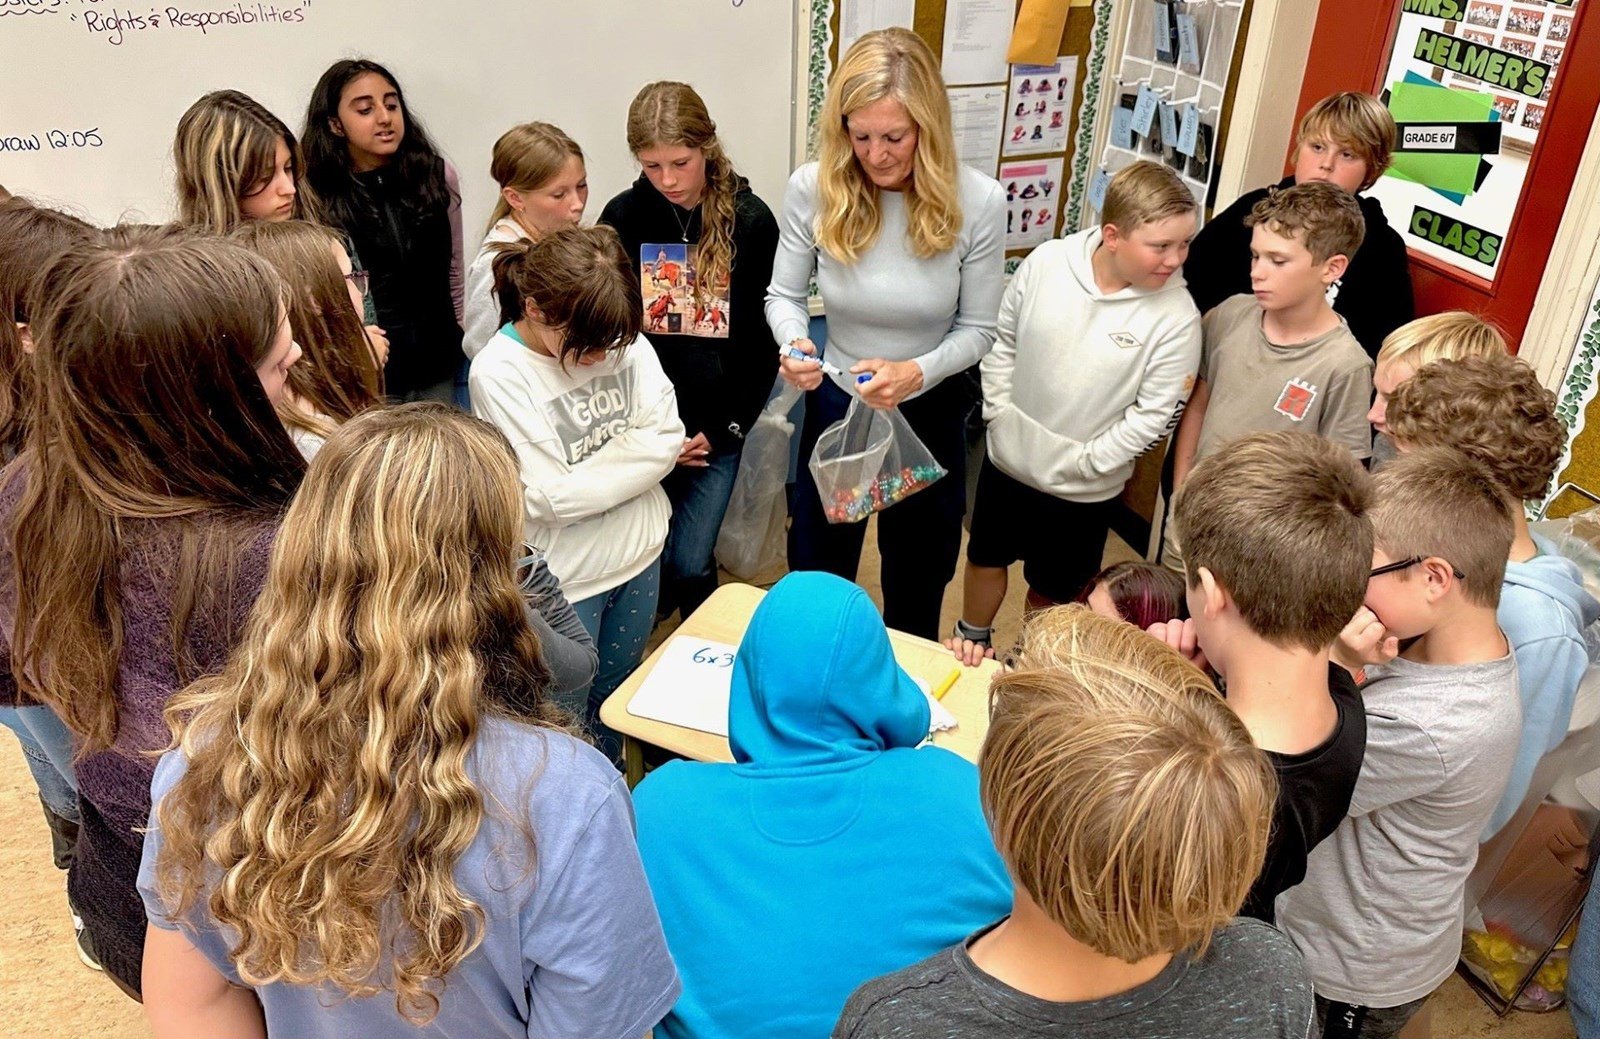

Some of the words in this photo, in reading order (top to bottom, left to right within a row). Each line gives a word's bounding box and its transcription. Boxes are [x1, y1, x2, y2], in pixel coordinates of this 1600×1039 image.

[1414, 31, 1546, 97] HELMER'S
[46, 127, 103, 149] 12:05
[1405, 133, 1438, 143] GRADE
[1440, 133, 1455, 143] 6/7
[1411, 210, 1499, 264] CLASS
[571, 388, 625, 427] GOOD
[569, 418, 630, 463] ENRG
